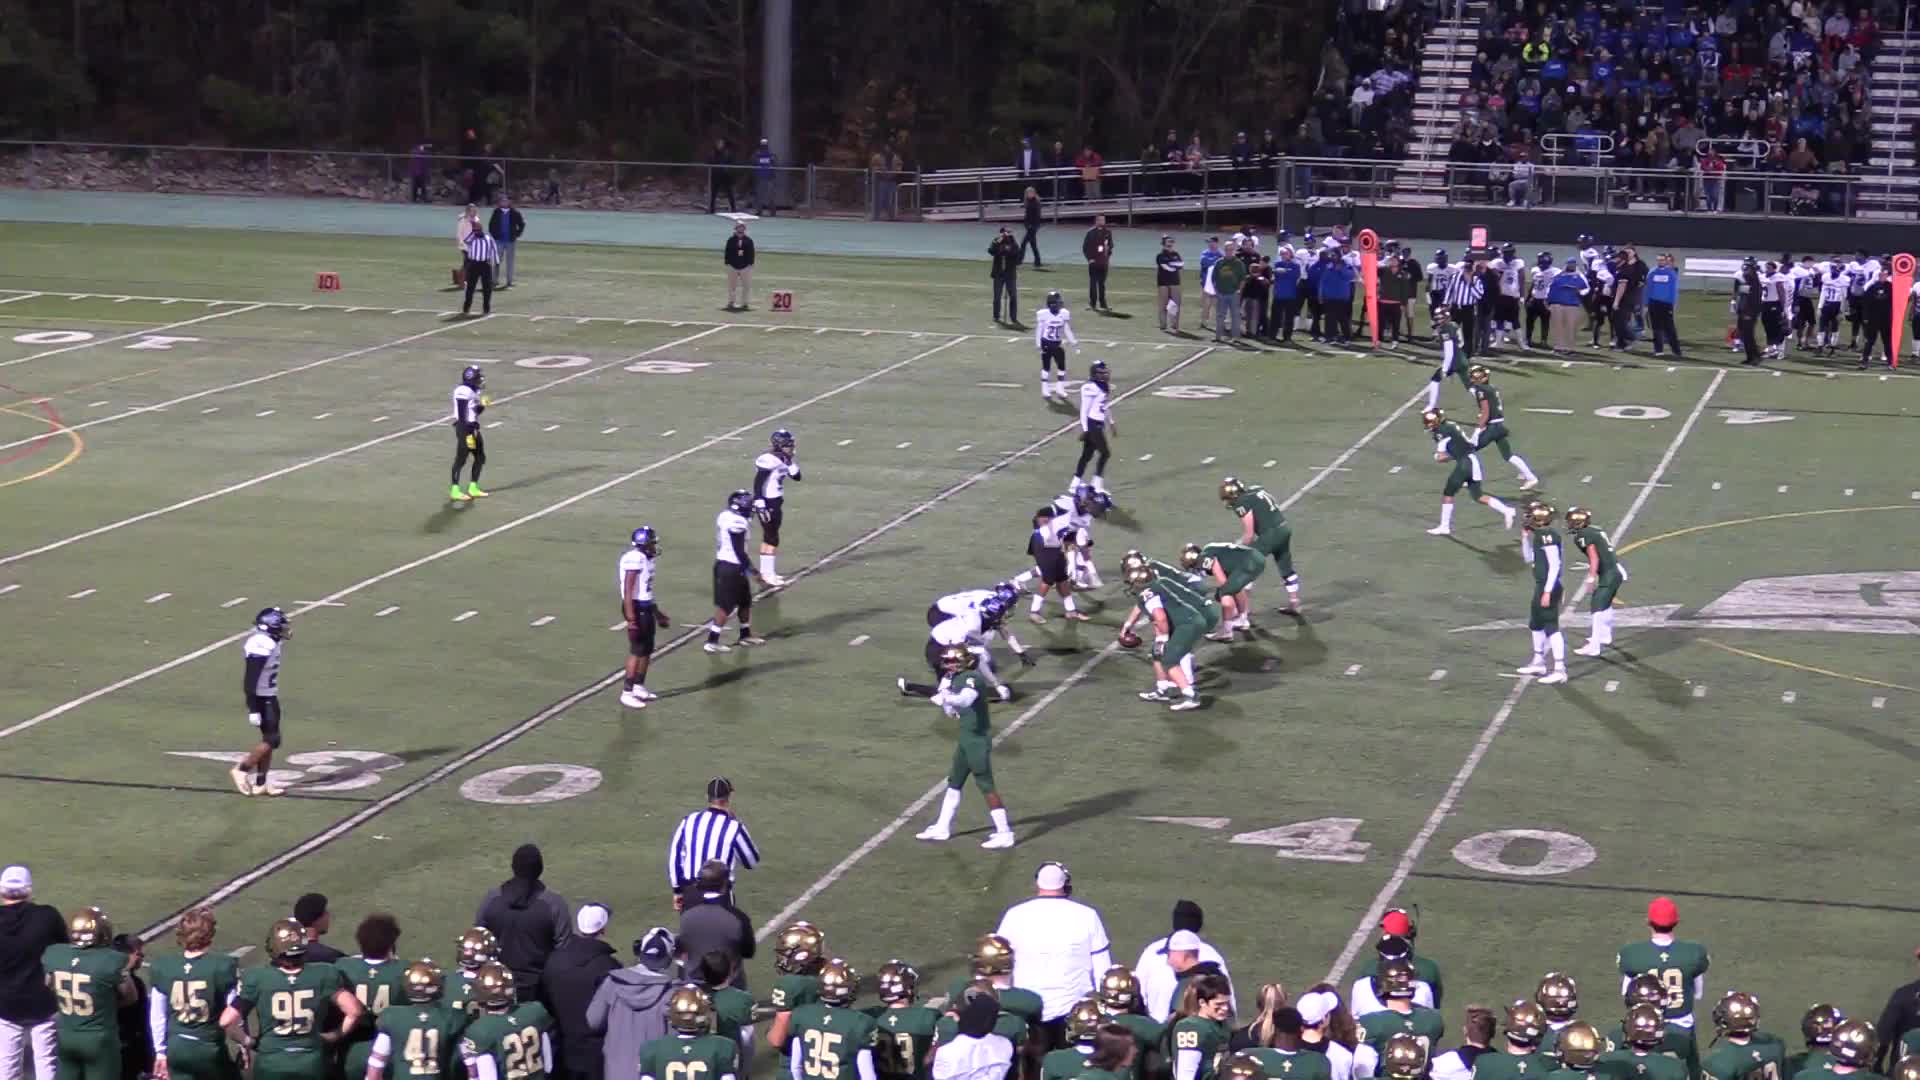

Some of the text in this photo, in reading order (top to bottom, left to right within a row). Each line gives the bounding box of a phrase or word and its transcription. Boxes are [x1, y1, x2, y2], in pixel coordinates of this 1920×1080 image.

[773, 292, 792, 309] 20
[1227, 816, 1597, 876] 40
[53, 970, 94, 1017] 55
[170, 980, 209, 1024] 45
[271, 988, 315, 1035] 95
[404, 1027, 441, 1075] 41
[503, 1025, 544, 1079] 22
[803, 1028, 843, 1080] 35
[1176, 1031, 1199, 1049] 89
